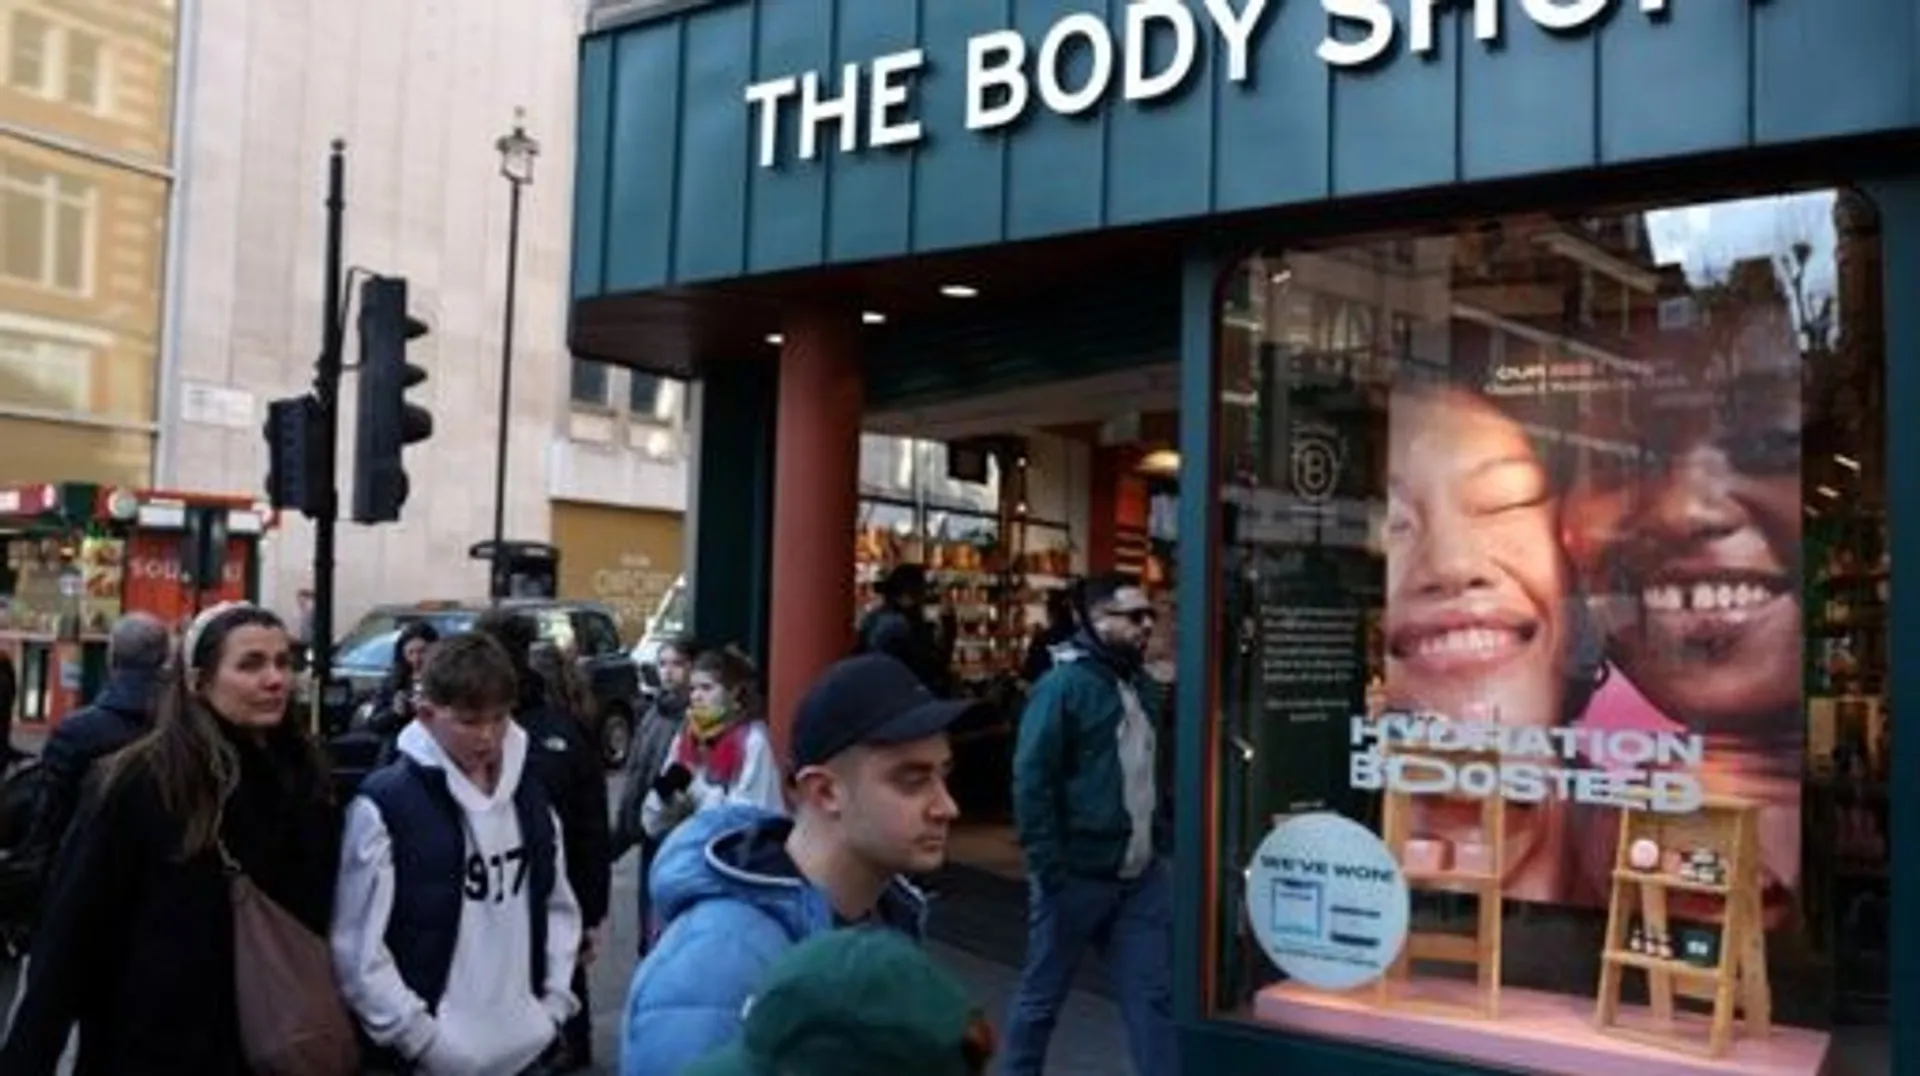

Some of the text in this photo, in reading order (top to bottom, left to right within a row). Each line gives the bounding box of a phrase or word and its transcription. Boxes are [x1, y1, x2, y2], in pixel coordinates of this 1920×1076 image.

[745, 49, 924, 167] THE
[964, 0, 1267, 129] BODY
[1350, 713, 1704, 768] HYDRATION
[1350, 751, 1702, 814] BOOSTED
[1260, 855, 1328, 875] WE'VE
